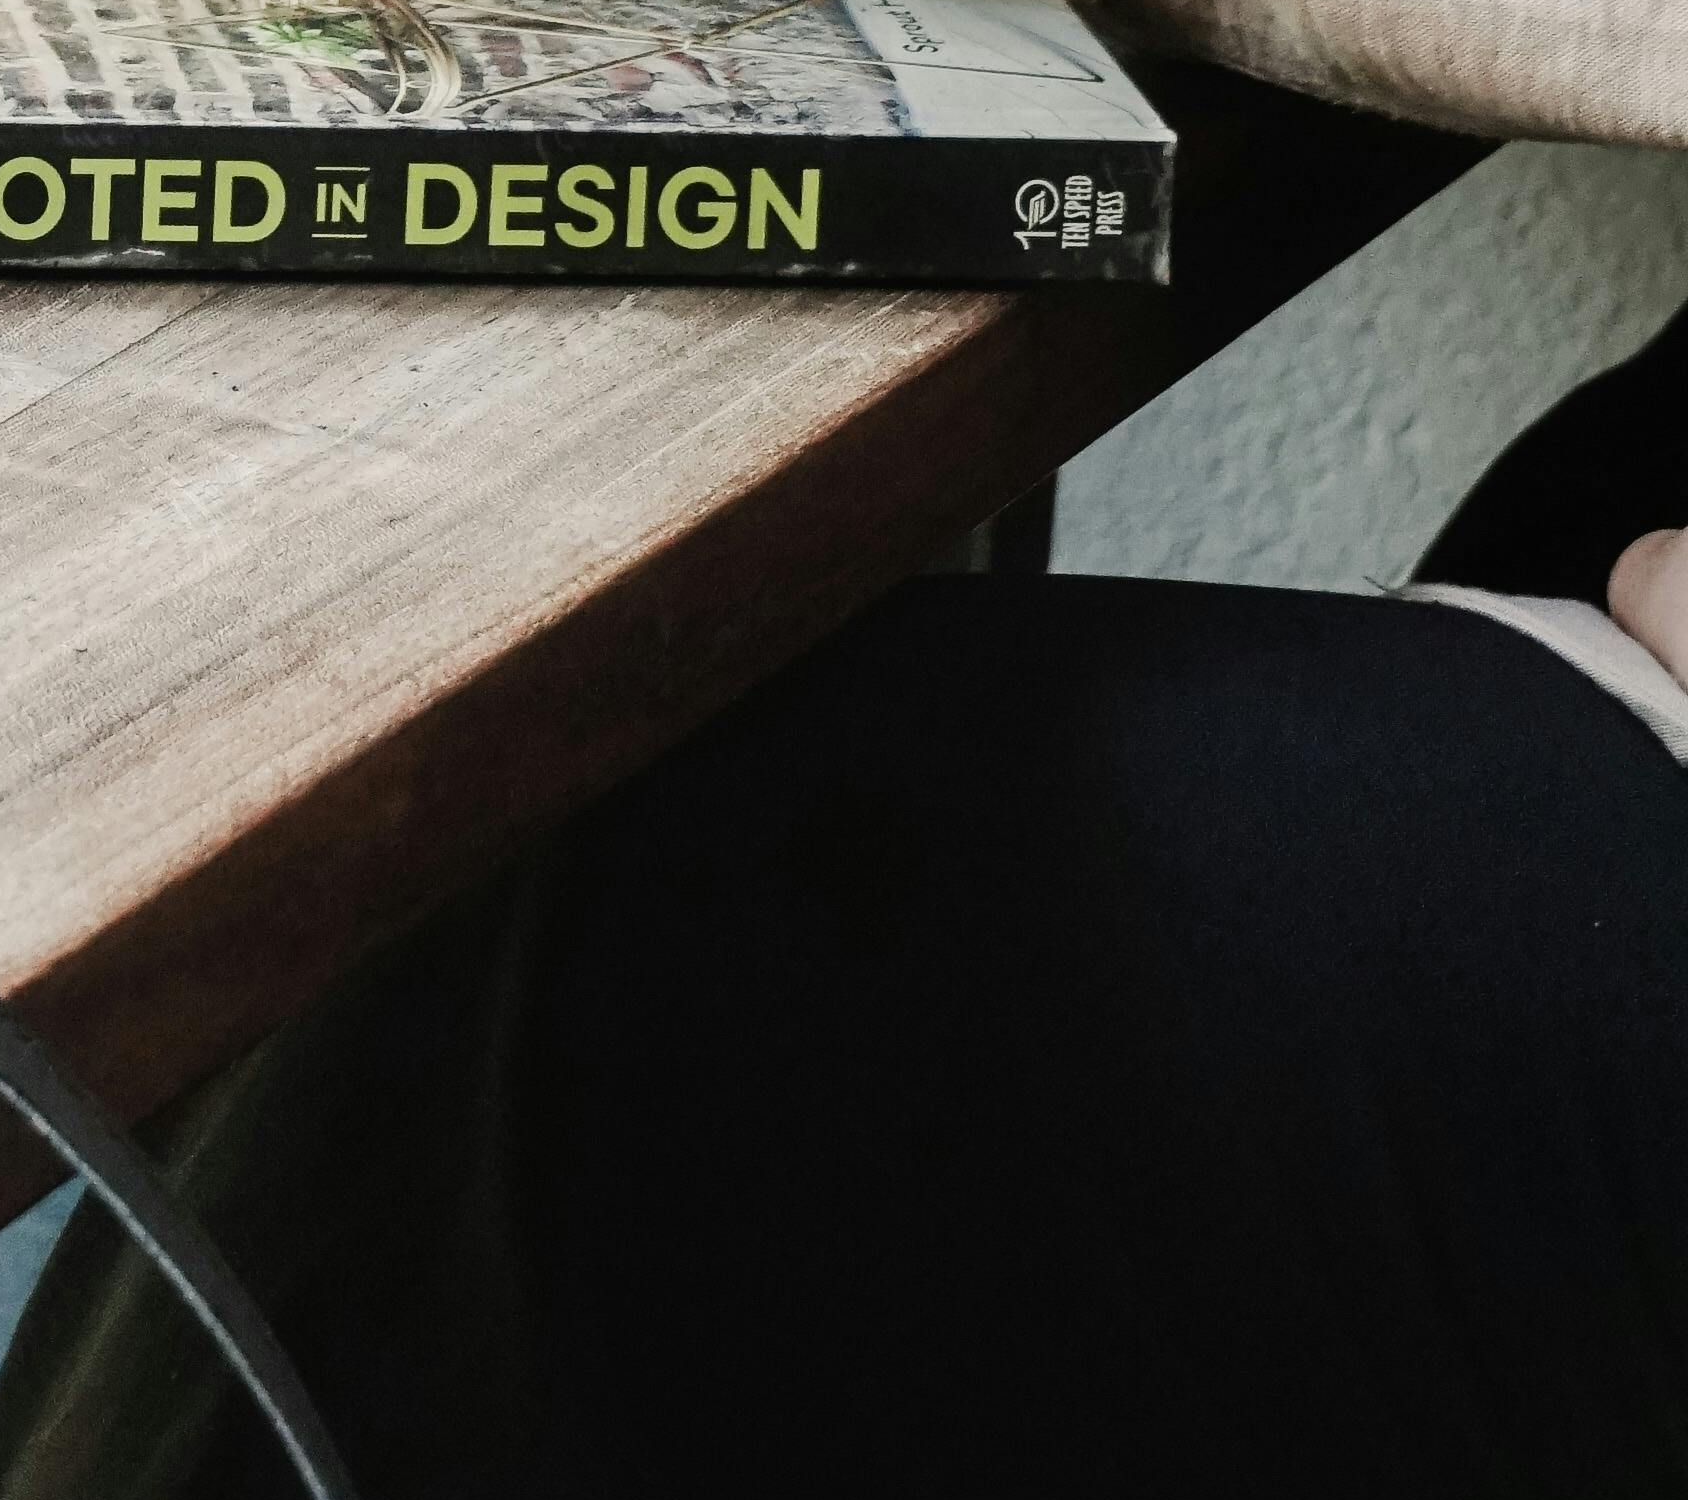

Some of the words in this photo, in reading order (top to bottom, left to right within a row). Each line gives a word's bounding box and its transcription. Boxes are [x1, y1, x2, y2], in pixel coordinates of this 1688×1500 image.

[314, 180, 369, 225] IN
[404, 162, 821, 251] DESIGN
[1063, 174, 1093, 219] SPEED
[1094, 190, 1126, 236] PRESS
[1062, 221, 1091, 249] TEN
